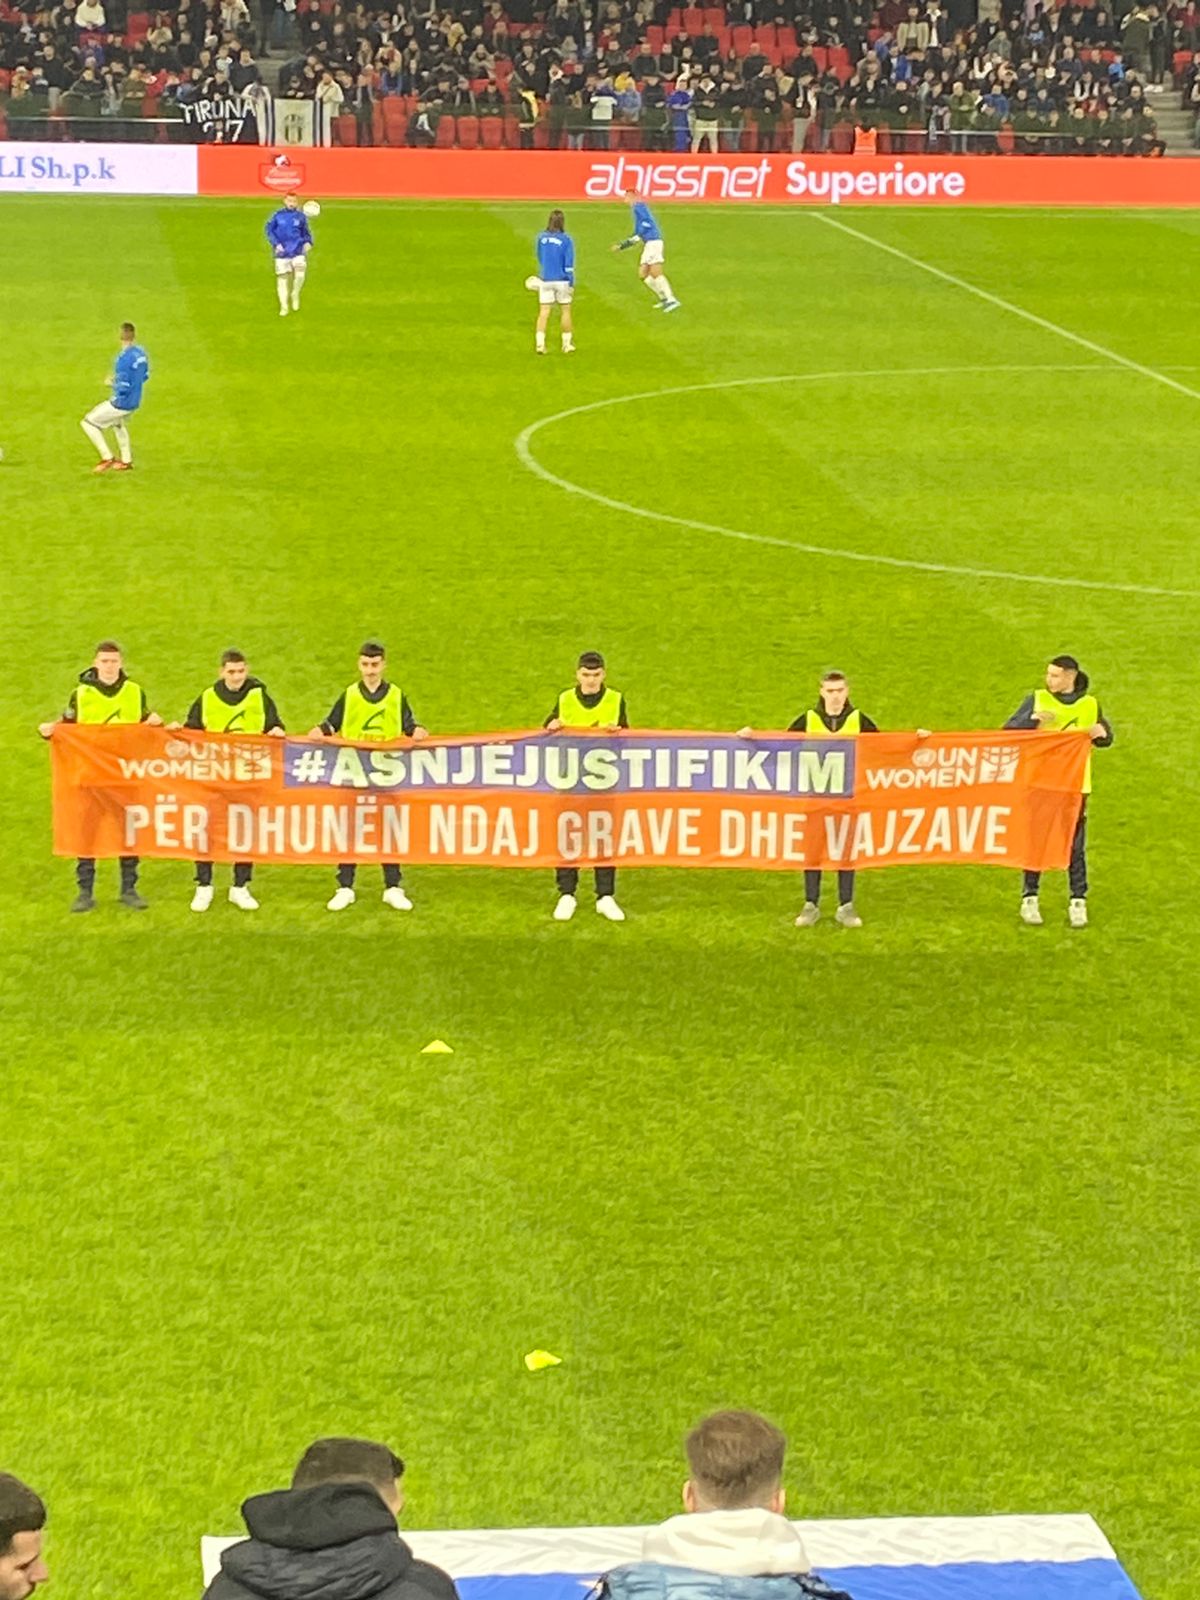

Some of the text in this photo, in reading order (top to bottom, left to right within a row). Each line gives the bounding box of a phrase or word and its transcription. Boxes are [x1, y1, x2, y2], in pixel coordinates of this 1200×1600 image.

[31, 156, 116, 187] Sh.p.k
[585, 156, 965, 204] abissnet Superiore
[190, 742, 231, 760] UN
[937, 747, 978, 767] UN
[117, 758, 231, 781] WOMEN
[865, 767, 976, 790] WOMEN
[124, 794, 1012, 862] PËR DHUNËN NDAJ GRAVE DHE VAJZAVE
